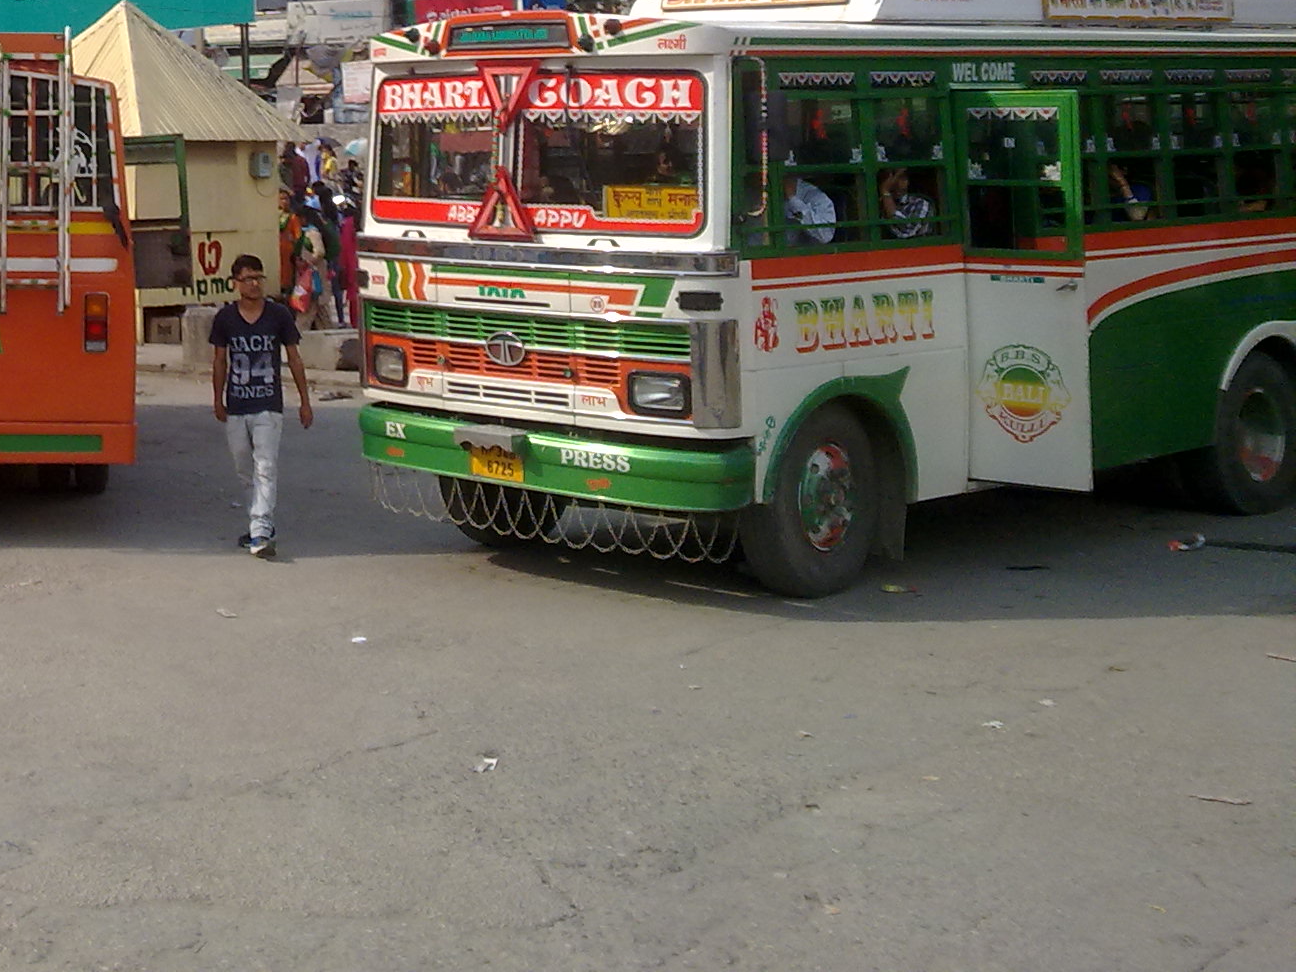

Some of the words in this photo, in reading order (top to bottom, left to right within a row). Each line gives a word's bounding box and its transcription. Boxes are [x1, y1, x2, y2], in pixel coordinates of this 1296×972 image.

[534, 207, 587, 228] APPU
[794, 288, 936, 354] BHARTI
[231, 335, 276, 352] JACK
[232, 352, 275, 386] 94
[581, 394, 609, 408] लाभ
[385, 421, 407, 440] EX
[560, 447, 632, 474] PRESS
